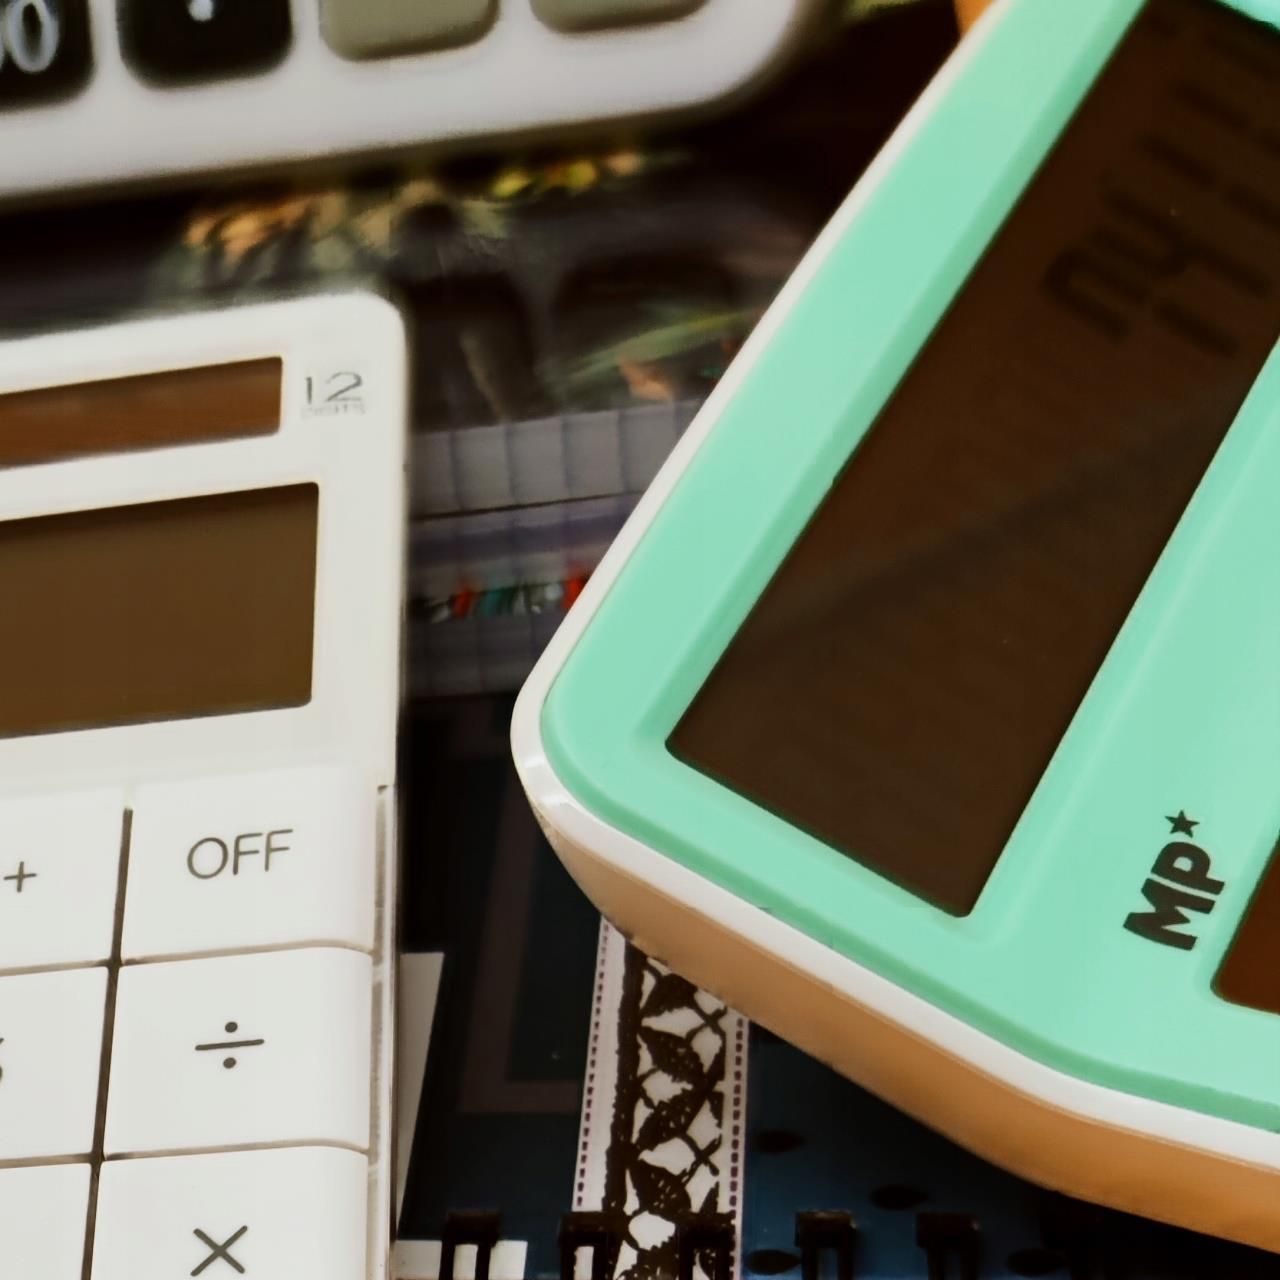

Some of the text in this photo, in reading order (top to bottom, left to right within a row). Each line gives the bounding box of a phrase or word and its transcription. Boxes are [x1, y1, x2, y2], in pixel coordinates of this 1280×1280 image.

[304, 370, 363, 405] 12
[186, 828, 294, 880] OFF
[1122, 841, 1225, 951] MP
